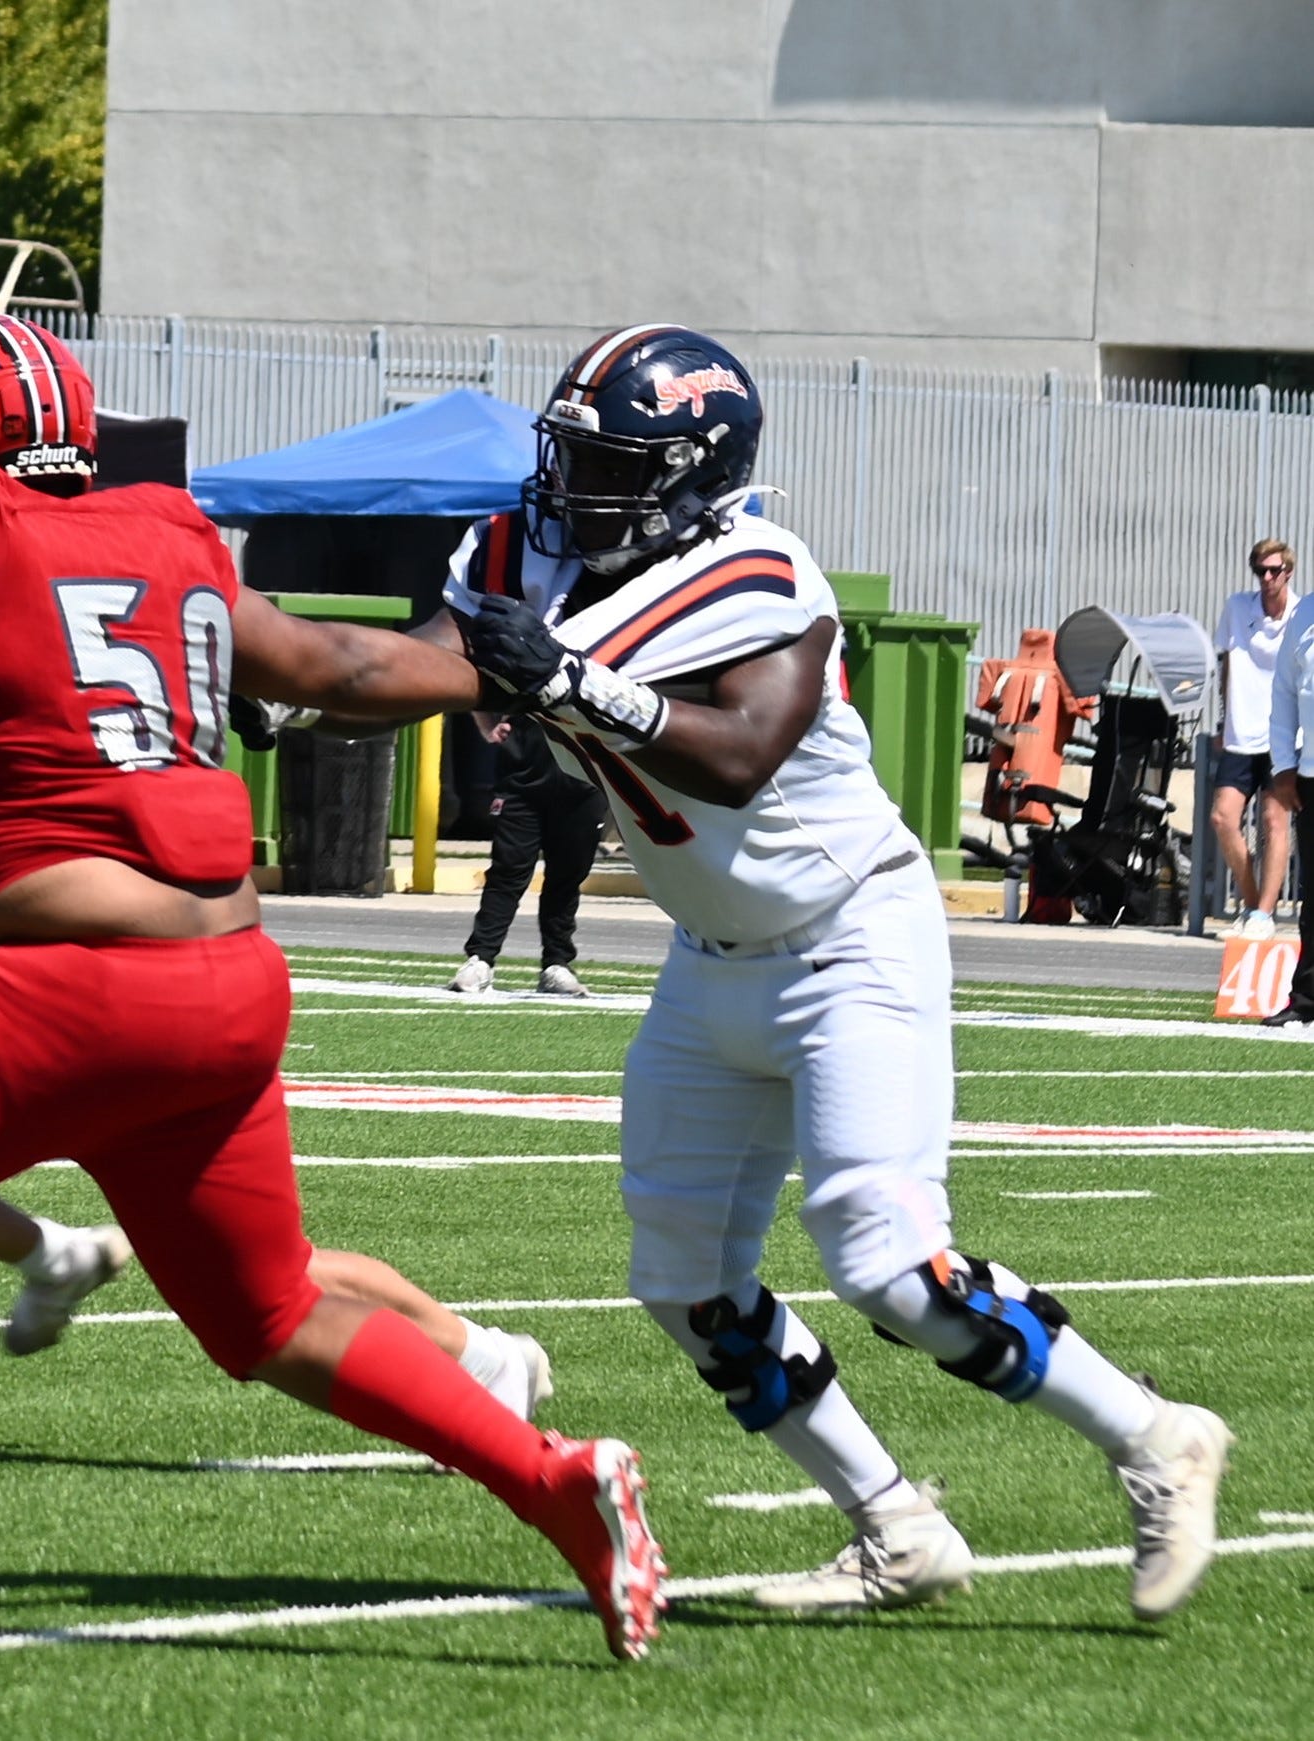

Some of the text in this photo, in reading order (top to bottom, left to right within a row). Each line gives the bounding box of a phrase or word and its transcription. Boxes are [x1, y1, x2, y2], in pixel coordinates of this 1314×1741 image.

[16, 444, 78, 466] schutt
[50, 577, 234, 772] 50
[1218, 941, 1300, 1018] 40
